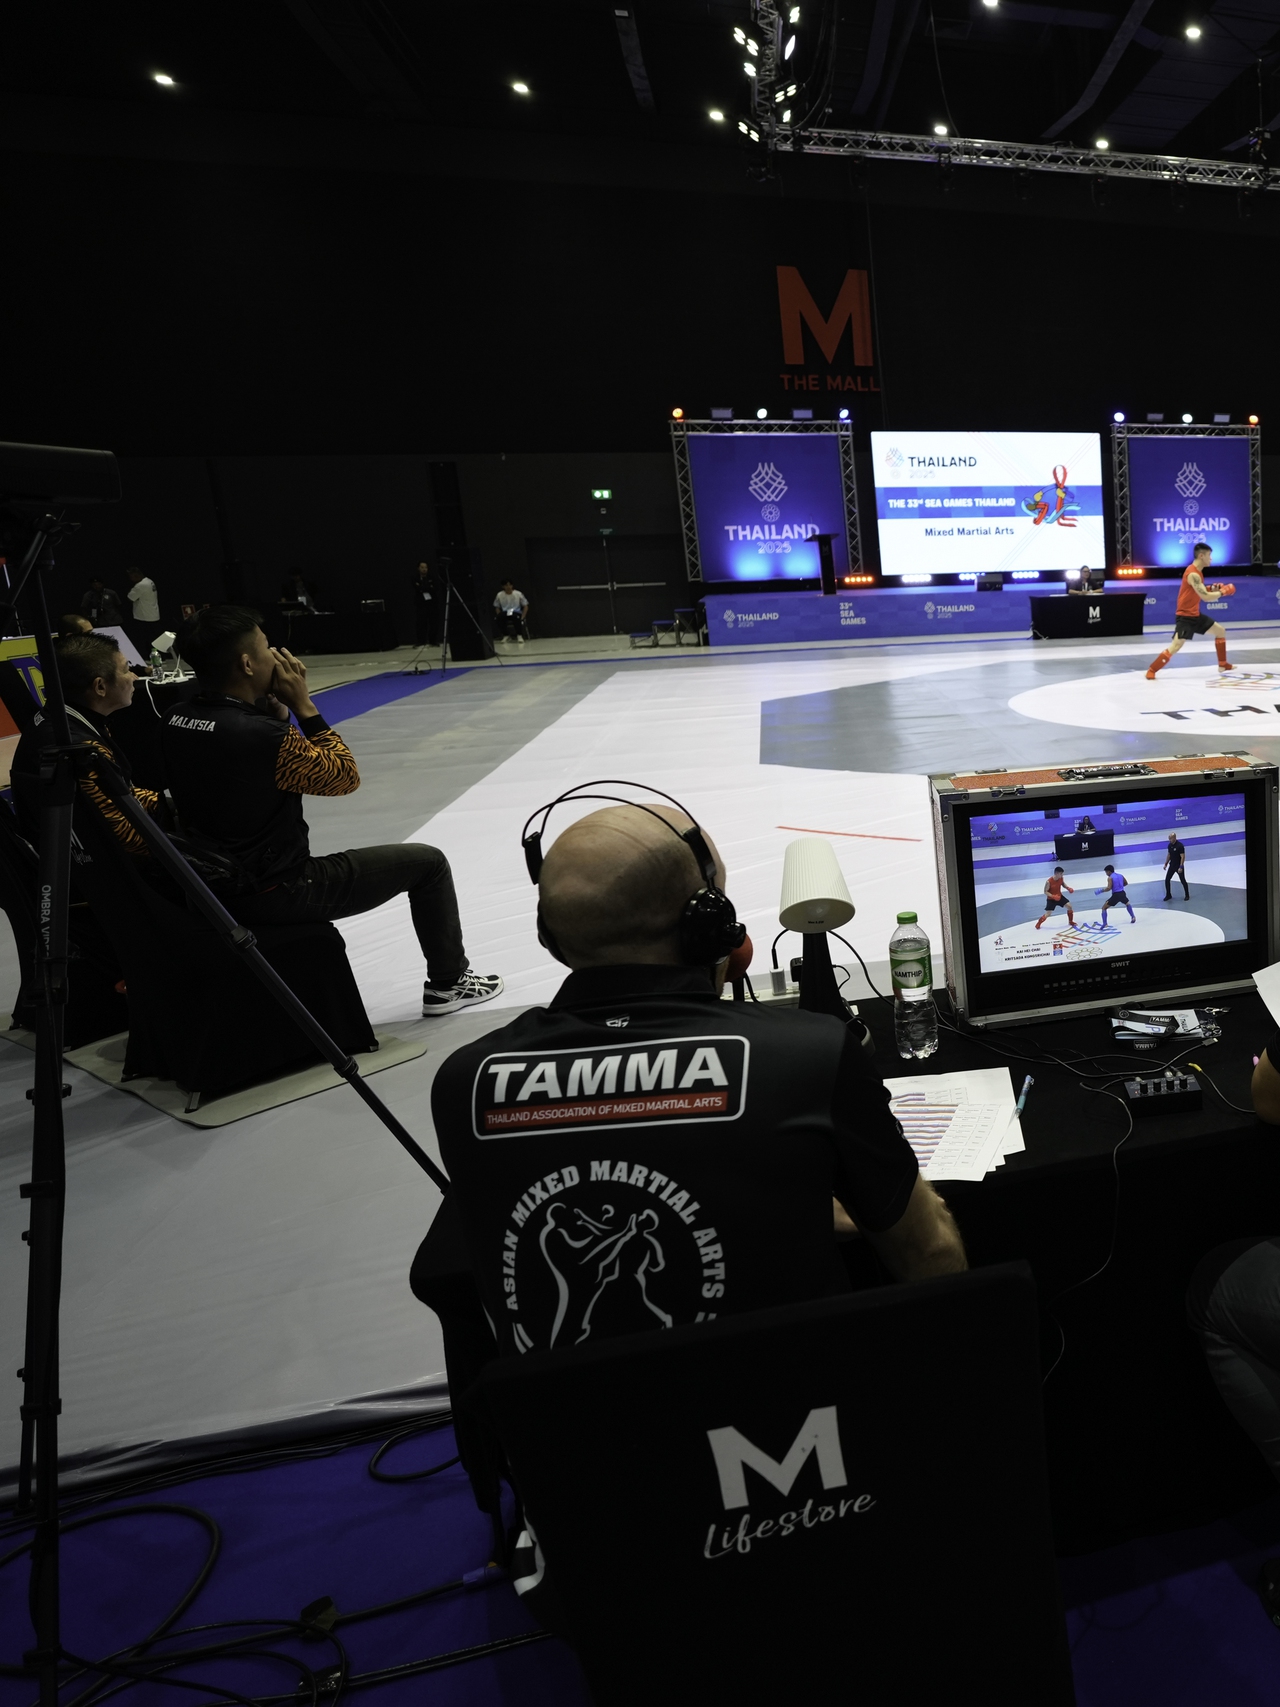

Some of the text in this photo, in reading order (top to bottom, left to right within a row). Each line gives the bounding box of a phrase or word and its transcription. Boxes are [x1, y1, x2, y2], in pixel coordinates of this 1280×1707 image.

[776, 265, 873, 367] M
[779, 374, 881, 392] THE MALL
[907, 456, 978, 468] THAILAND
[888, 499, 906, 509] THE
[924, 498, 943, 508] SEA
[944, 498, 973, 508] GAMES
[974, 497, 1016, 507] THAILAND
[1153, 517, 1231, 532] THAILAND
[724, 523, 820, 541] THAILAND
[925, 527, 1015, 537] Mixed Martial Arts
[1178, 532, 1207, 544] 2025
[757, 541, 792, 554] 2025
[840, 610, 855, 618] SEA
[936, 604, 976, 613] THAILAND
[1089, 606, 1100, 618] M
[737, 612, 779, 622] THAILAND
[841, 617, 866, 625] GAMES
[168, 714, 216, 732] MALAYSIA
[40, 884, 52, 924] OMBRA
[1110, 960, 1131, 968] SWIT
[894, 970, 923, 978] NAMTHIP
[487, 1047, 729, 1103] TAMMA
[487, 1096, 722, 1125] THAILAND ASSOCIATION OF MIXED MARTIAL ARTS
[502, 1160, 726, 1311] ASIAN MIXED MARTIAL ARTS
[706, 1405, 848, 1510] M
[703, 1493, 877, 1559] Lifestore
